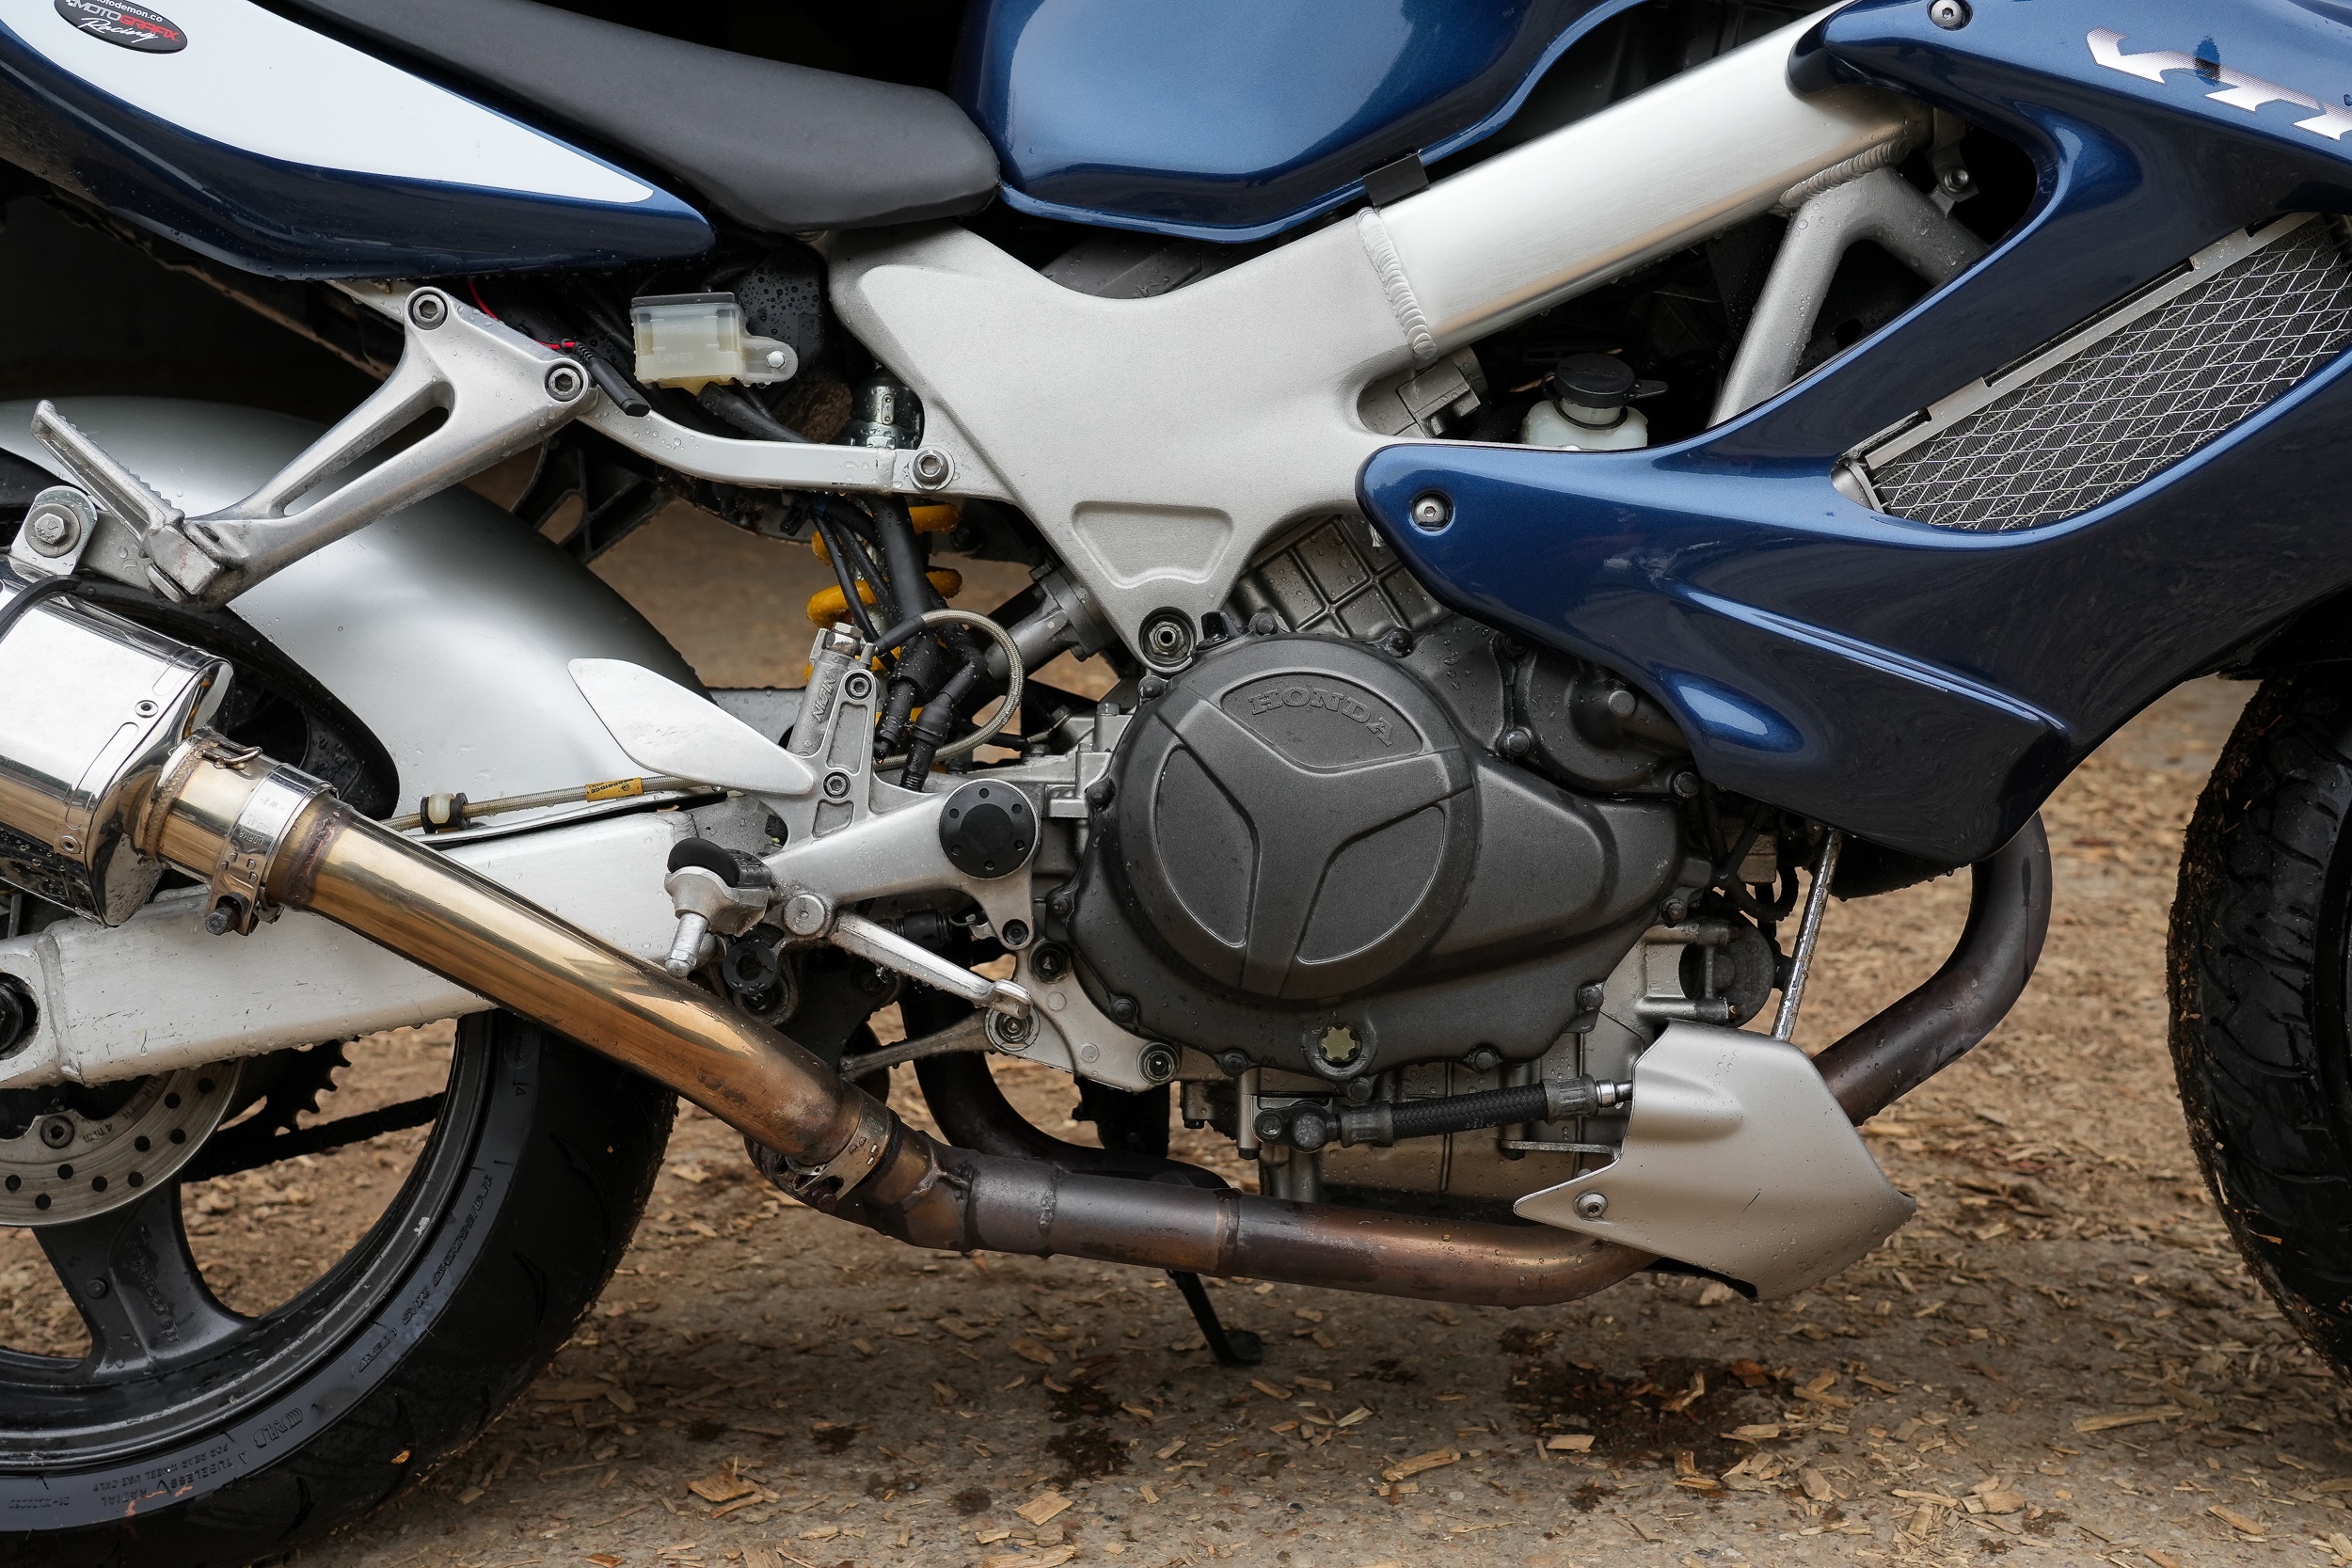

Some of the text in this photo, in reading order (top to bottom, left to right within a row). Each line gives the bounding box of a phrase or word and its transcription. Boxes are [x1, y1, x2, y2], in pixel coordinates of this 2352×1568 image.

[96, 0, 163, 23] otodemon.co
[78, 18, 158, 43] Racing
[658, 352, 693, 364] LOWER
[1248, 686, 1393, 747] HONDA
[171, 1459, 233, 1489] TUBELESS
[100, 1487, 149, 1507] RADIAL
